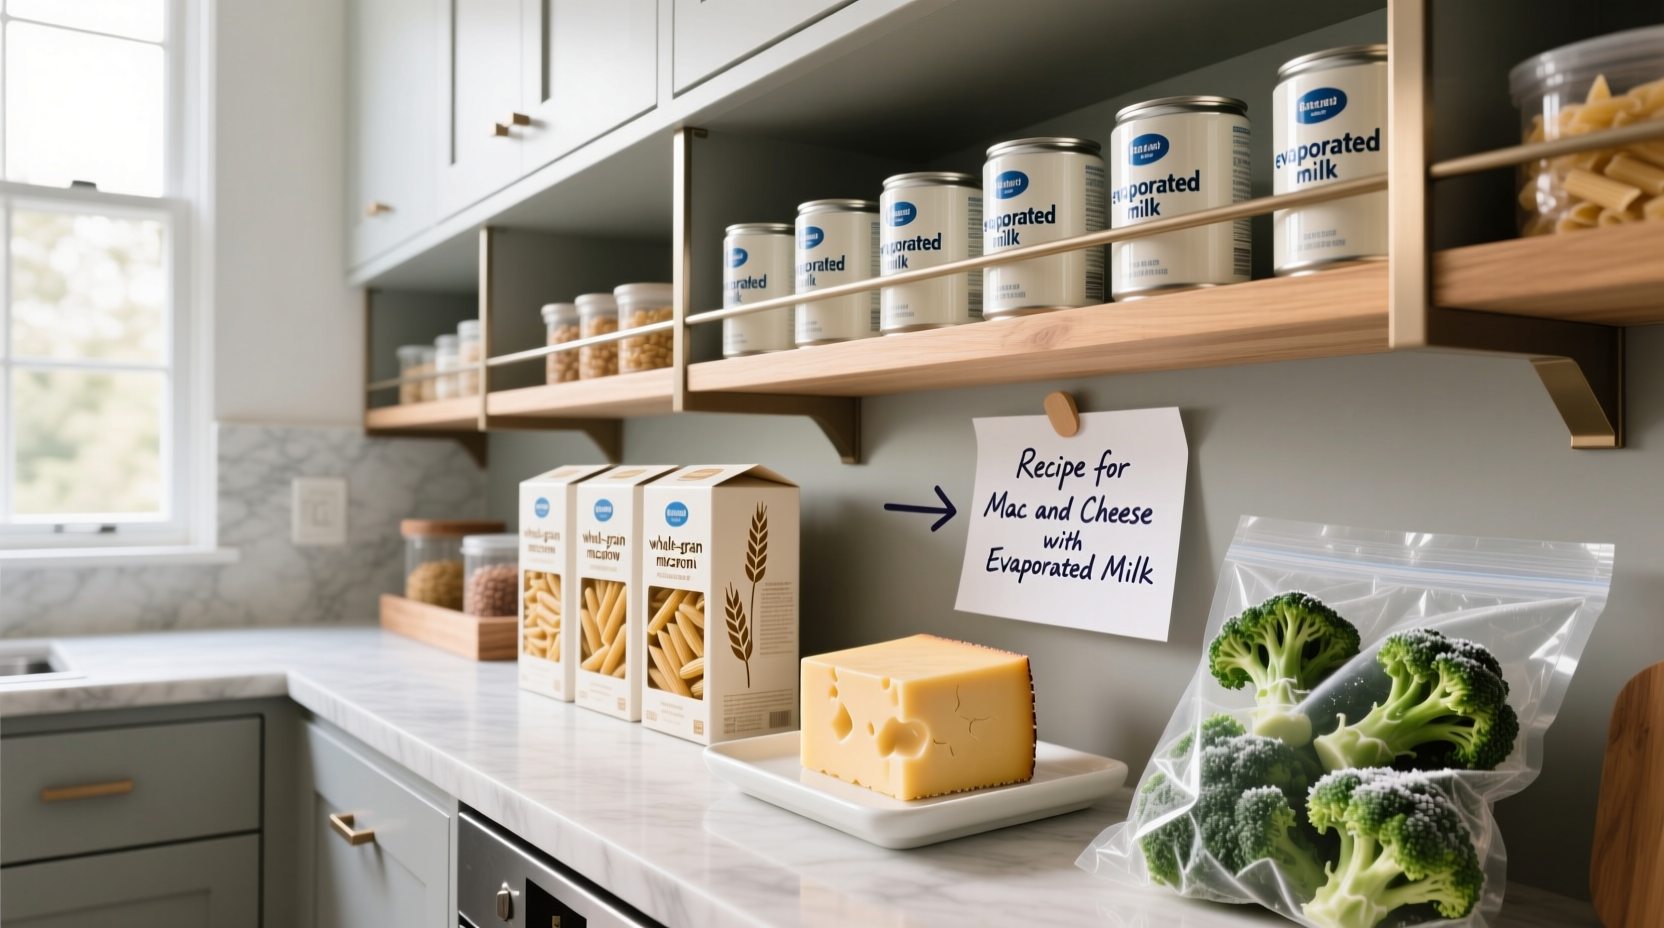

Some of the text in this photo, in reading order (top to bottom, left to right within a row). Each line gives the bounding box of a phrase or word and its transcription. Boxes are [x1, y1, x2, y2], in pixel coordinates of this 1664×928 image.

[1275, 127, 1380, 169] evaporated
[1296, 158, 1338, 184] milk
[1127, 197, 1161, 220] milk
[1015, 447, 1131, 490] Recipe for
[983, 490, 1153, 525] Mac and Cheese
[1043, 529, 1082, 551] with
[985, 546, 1154, 585] Evaporated Milk
